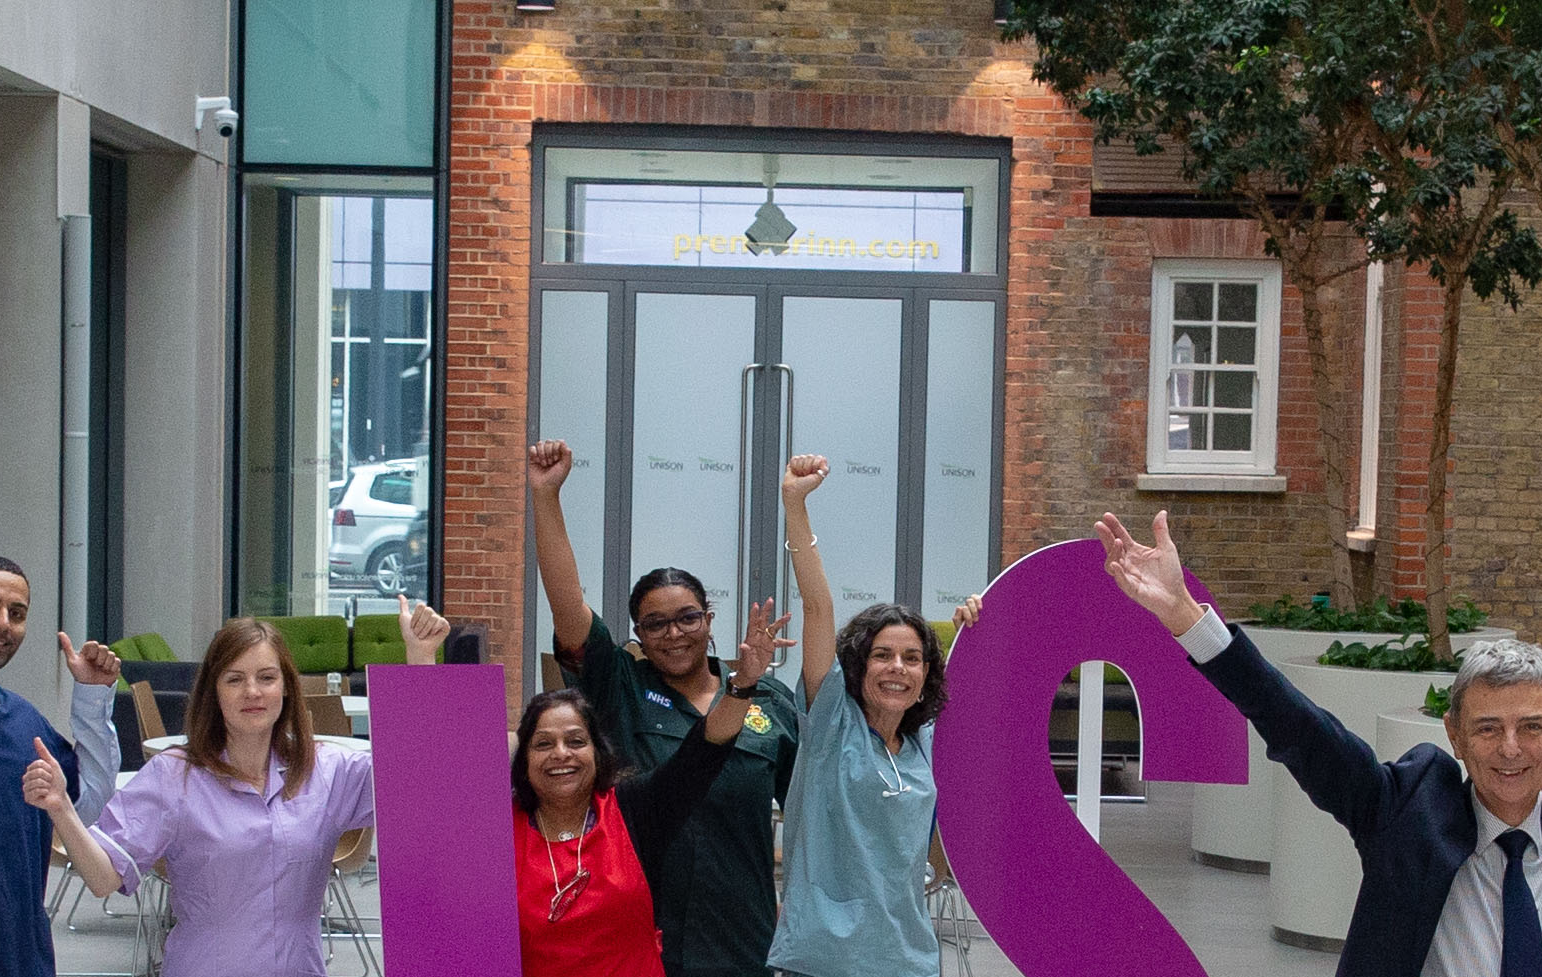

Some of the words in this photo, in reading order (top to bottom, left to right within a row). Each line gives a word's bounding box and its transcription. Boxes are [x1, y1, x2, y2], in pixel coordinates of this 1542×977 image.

[674, 231, 939, 259] premrinn.com
[649, 461, 684, 471] UNISON
[699, 462, 734, 472] UNISON
[846, 465, 881, 475] UNISON
[941, 467, 975, 477] UNISON
[842, 591, 877, 601] UNISON
[647, 691, 672, 707] NHS
